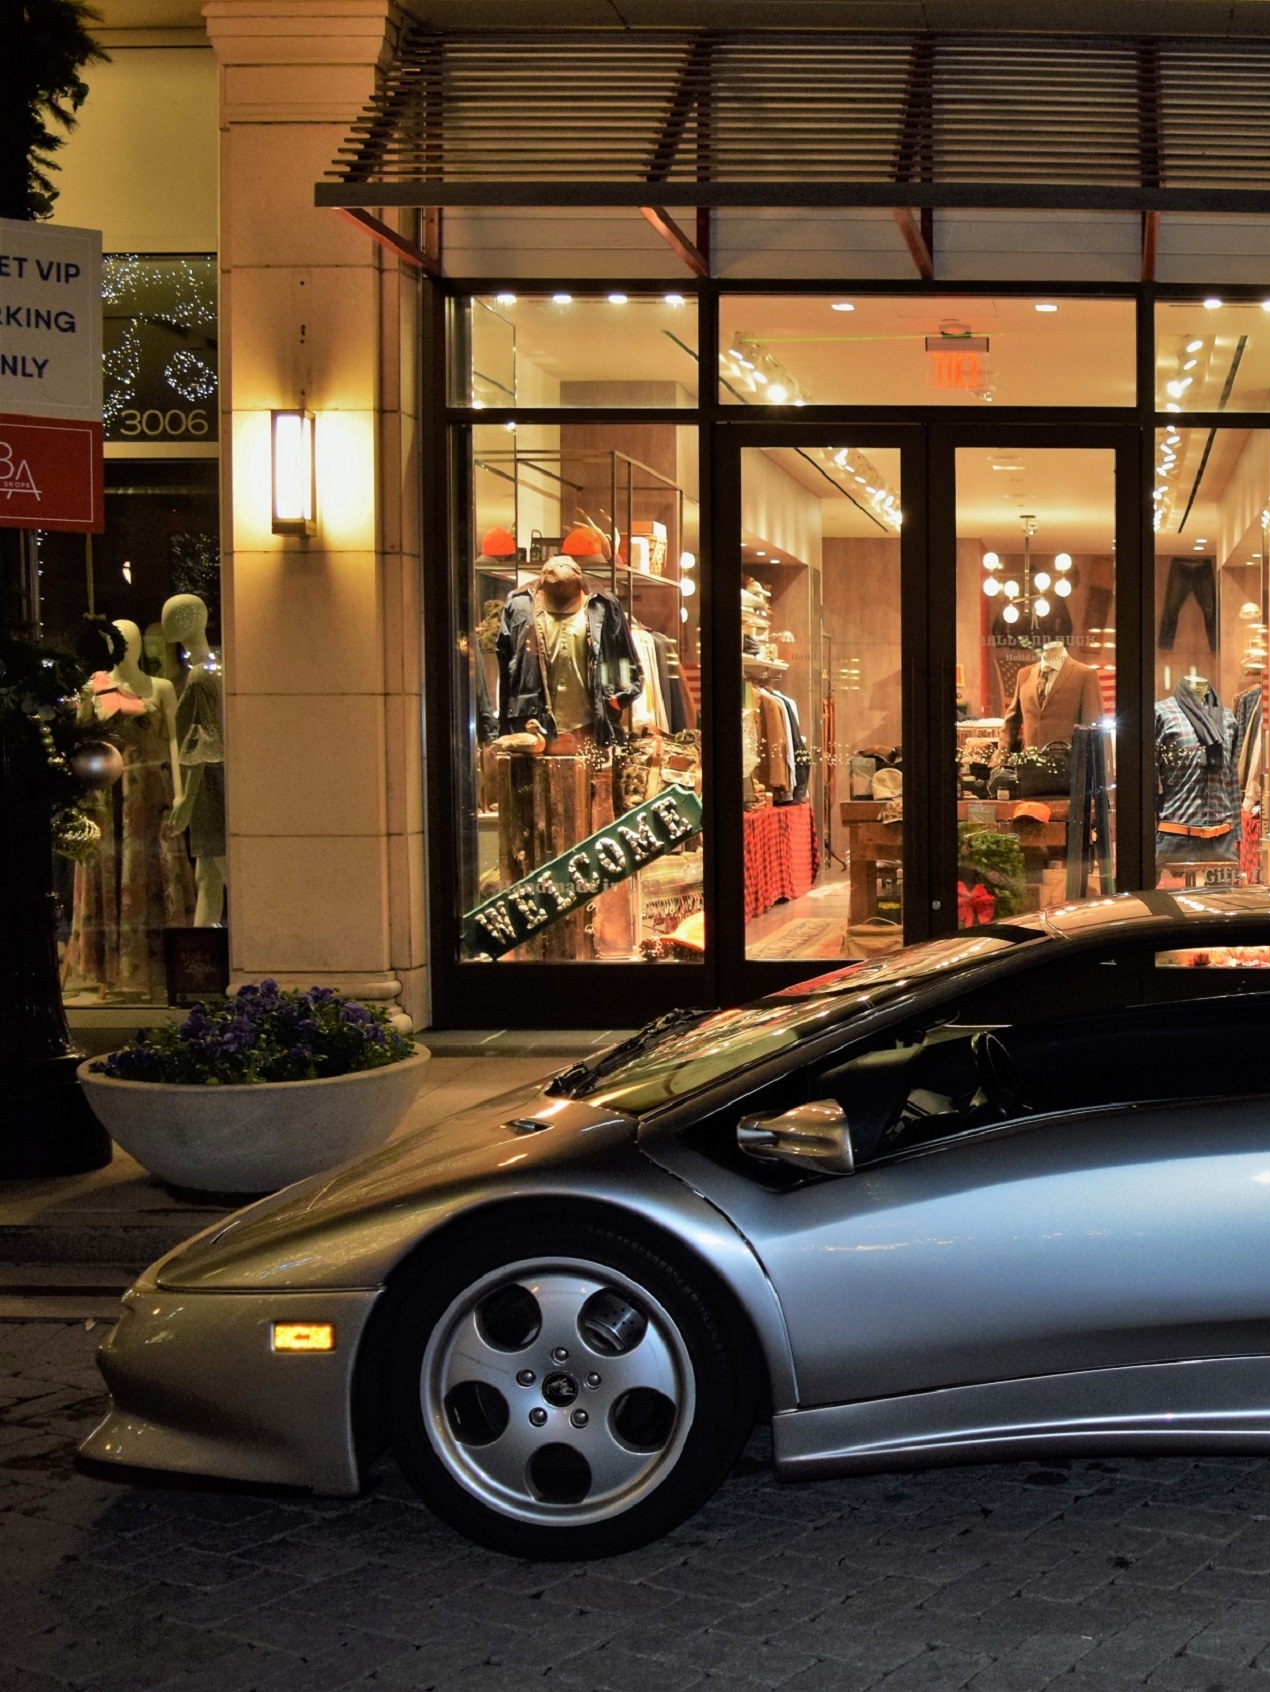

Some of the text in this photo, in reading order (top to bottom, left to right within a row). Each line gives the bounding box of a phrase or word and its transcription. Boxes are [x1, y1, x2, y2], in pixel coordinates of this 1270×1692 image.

[36, 258, 81, 284] VIP
[0, 305, 76, 333] KING
[119, 409, 208, 435] 3006
[4, 481, 31, 489] SHOPS
[475, 796, 693, 945] WELCOME
